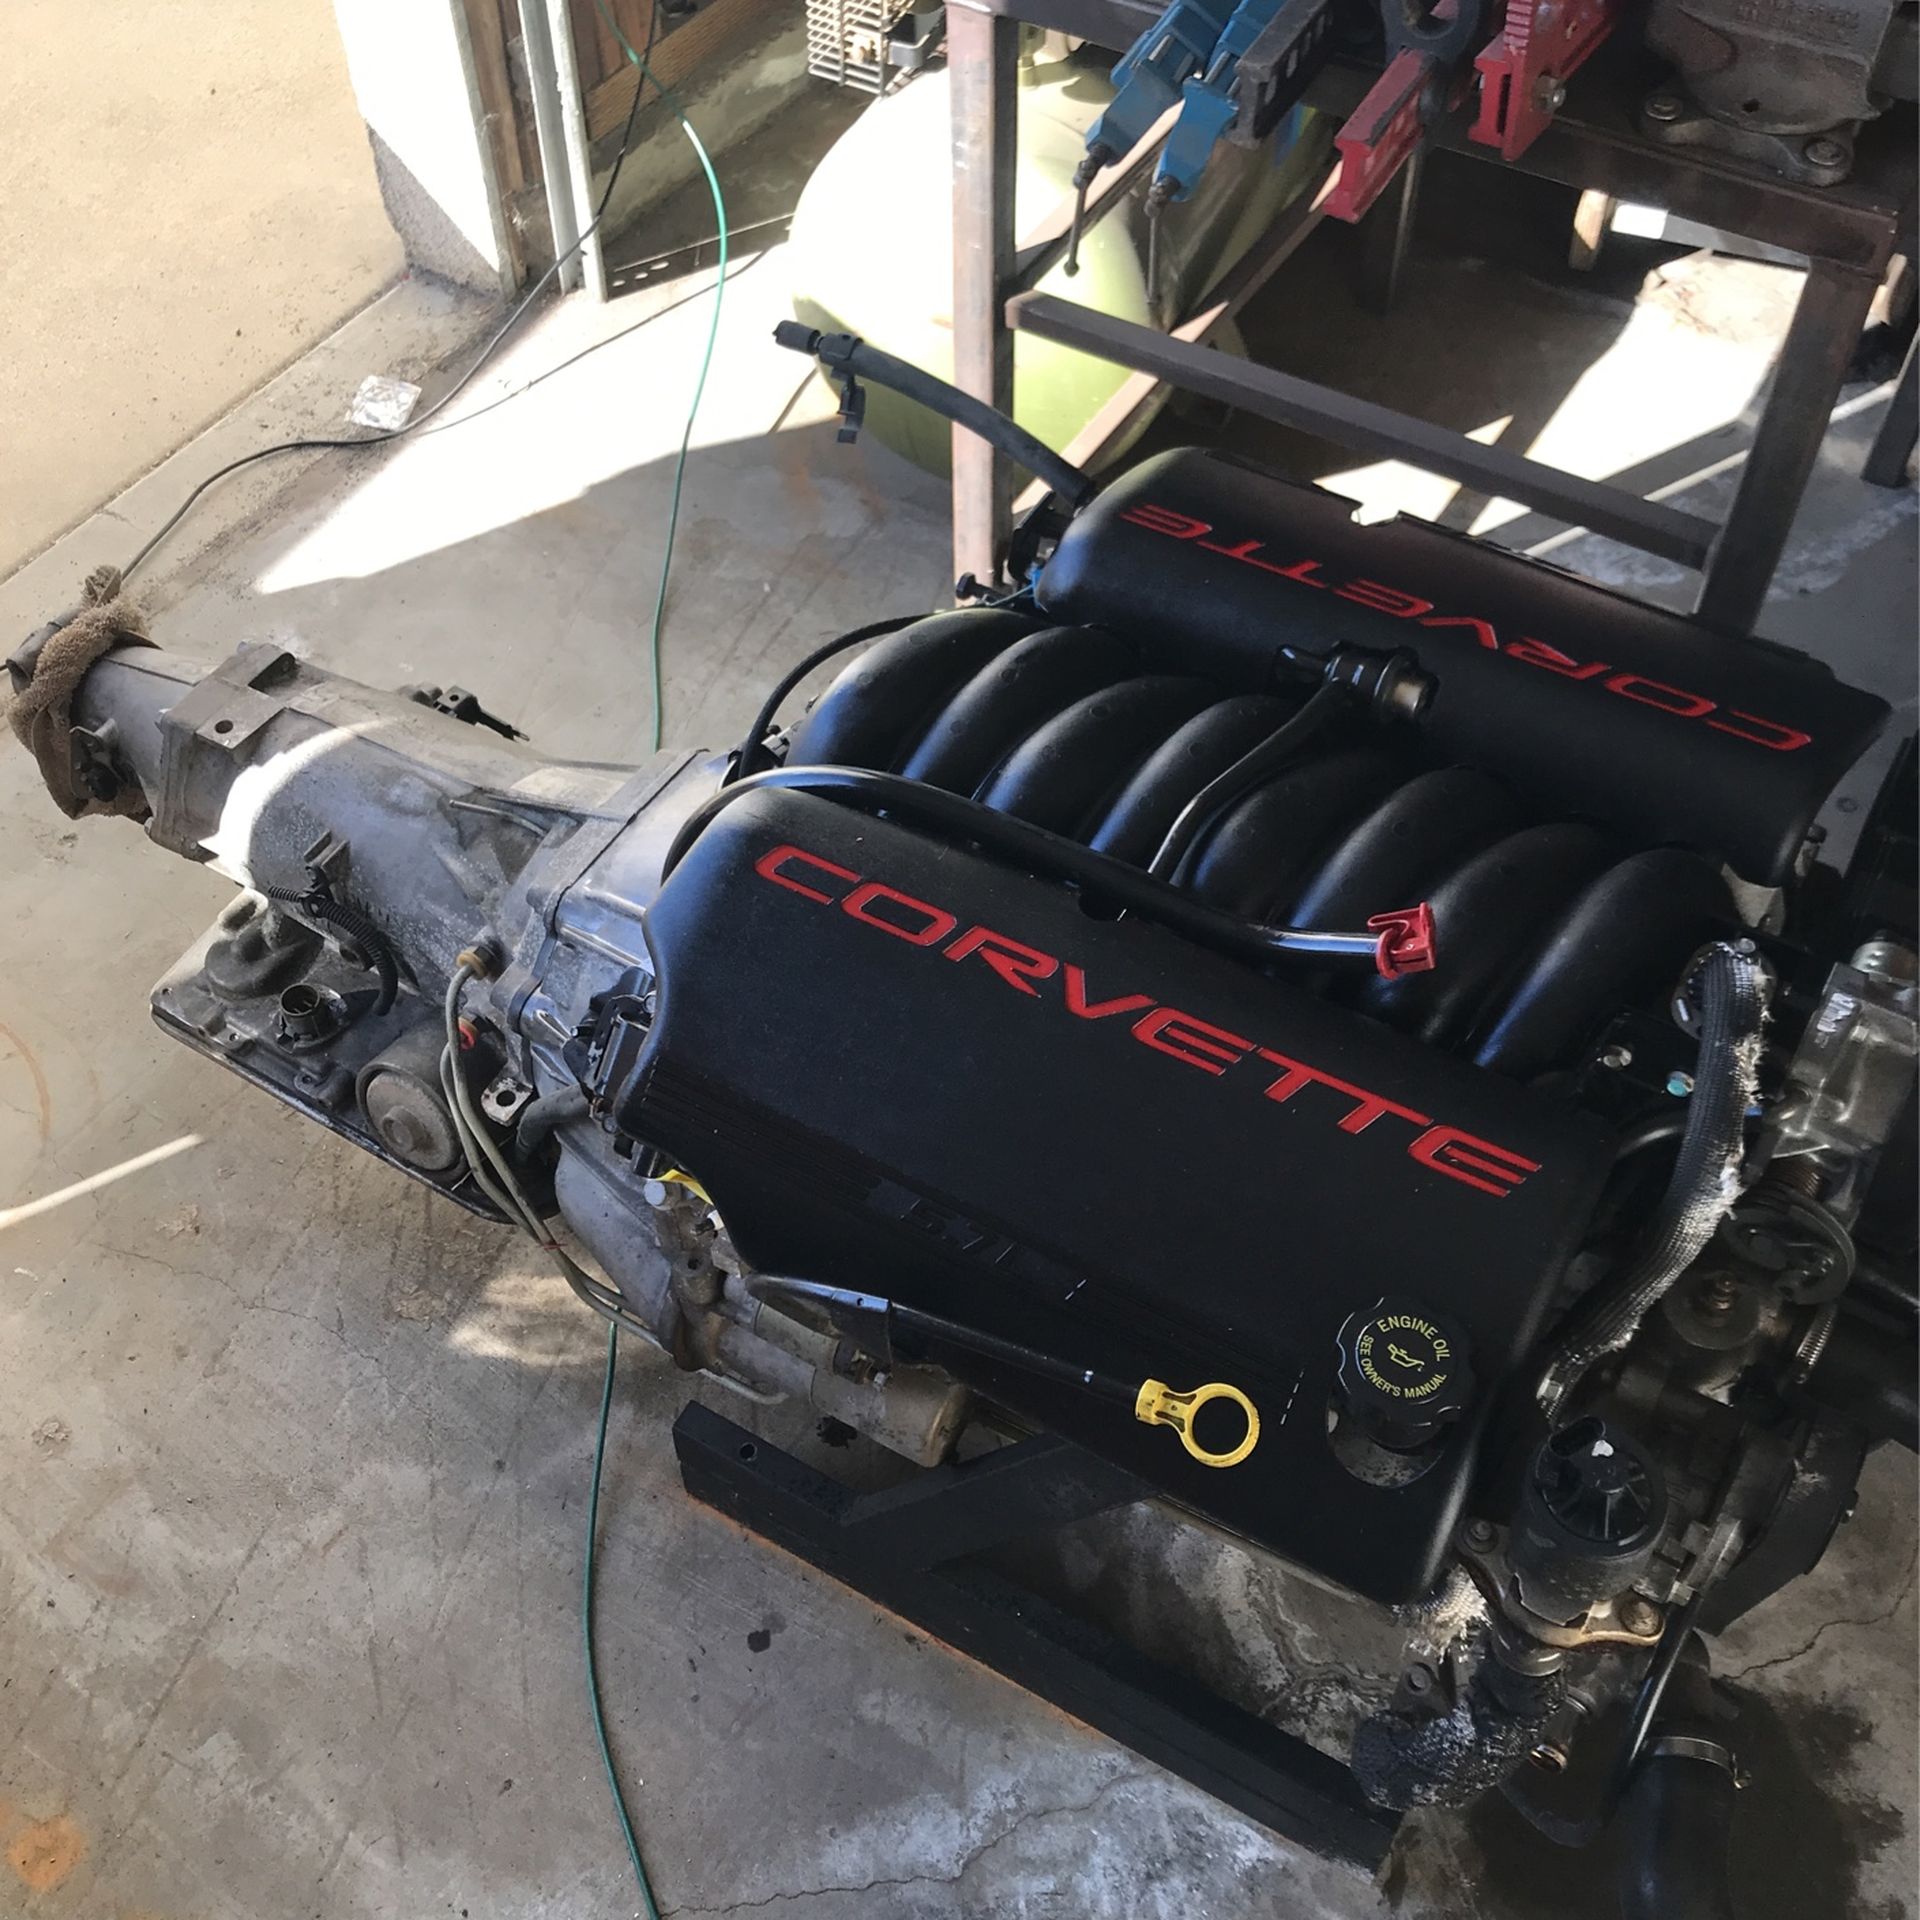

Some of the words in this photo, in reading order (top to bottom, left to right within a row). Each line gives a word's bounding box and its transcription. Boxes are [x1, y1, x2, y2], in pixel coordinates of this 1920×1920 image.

[1121, 505, 1813, 752] CORVETTE
[755, 844, 1541, 1198] CORVETTE
[1360, 1334, 1374, 1355] SEE
[1377, 1315, 1438, 1339] ENGINE
[1433, 1338, 1450, 1361] OIL
[1361, 1358, 1401, 1397] OWNER'S
[1404, 1373, 1447, 1398] MANUAL
